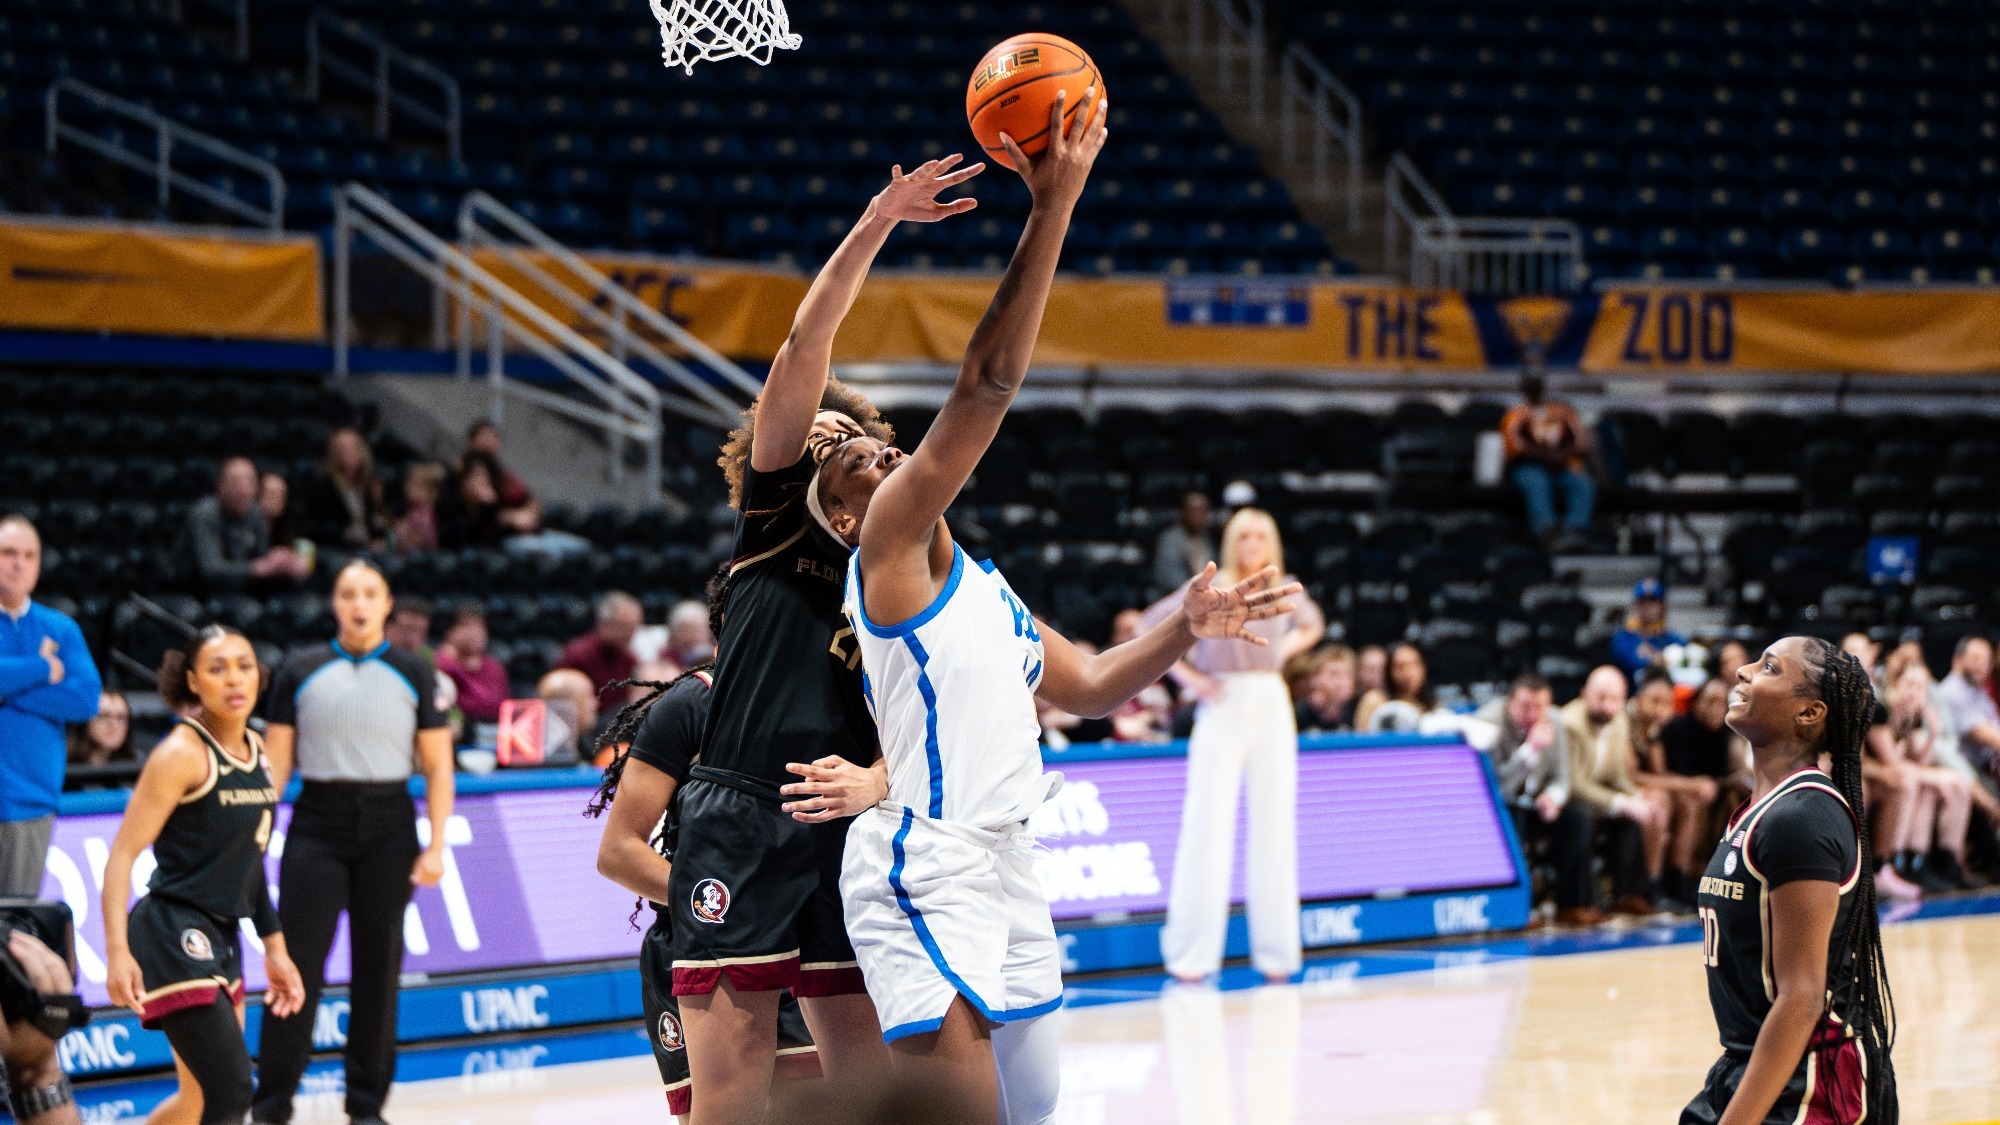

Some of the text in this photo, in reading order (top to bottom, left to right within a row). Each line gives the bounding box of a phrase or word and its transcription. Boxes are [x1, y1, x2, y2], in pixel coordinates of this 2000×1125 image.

[1341, 294, 1442, 361] THE
[1620, 293, 1734, 364] ZOO
[1709, 877, 1745, 901] STATE
[461, 984, 550, 1033] UPMC
[56, 1023, 136, 1073] PMC
